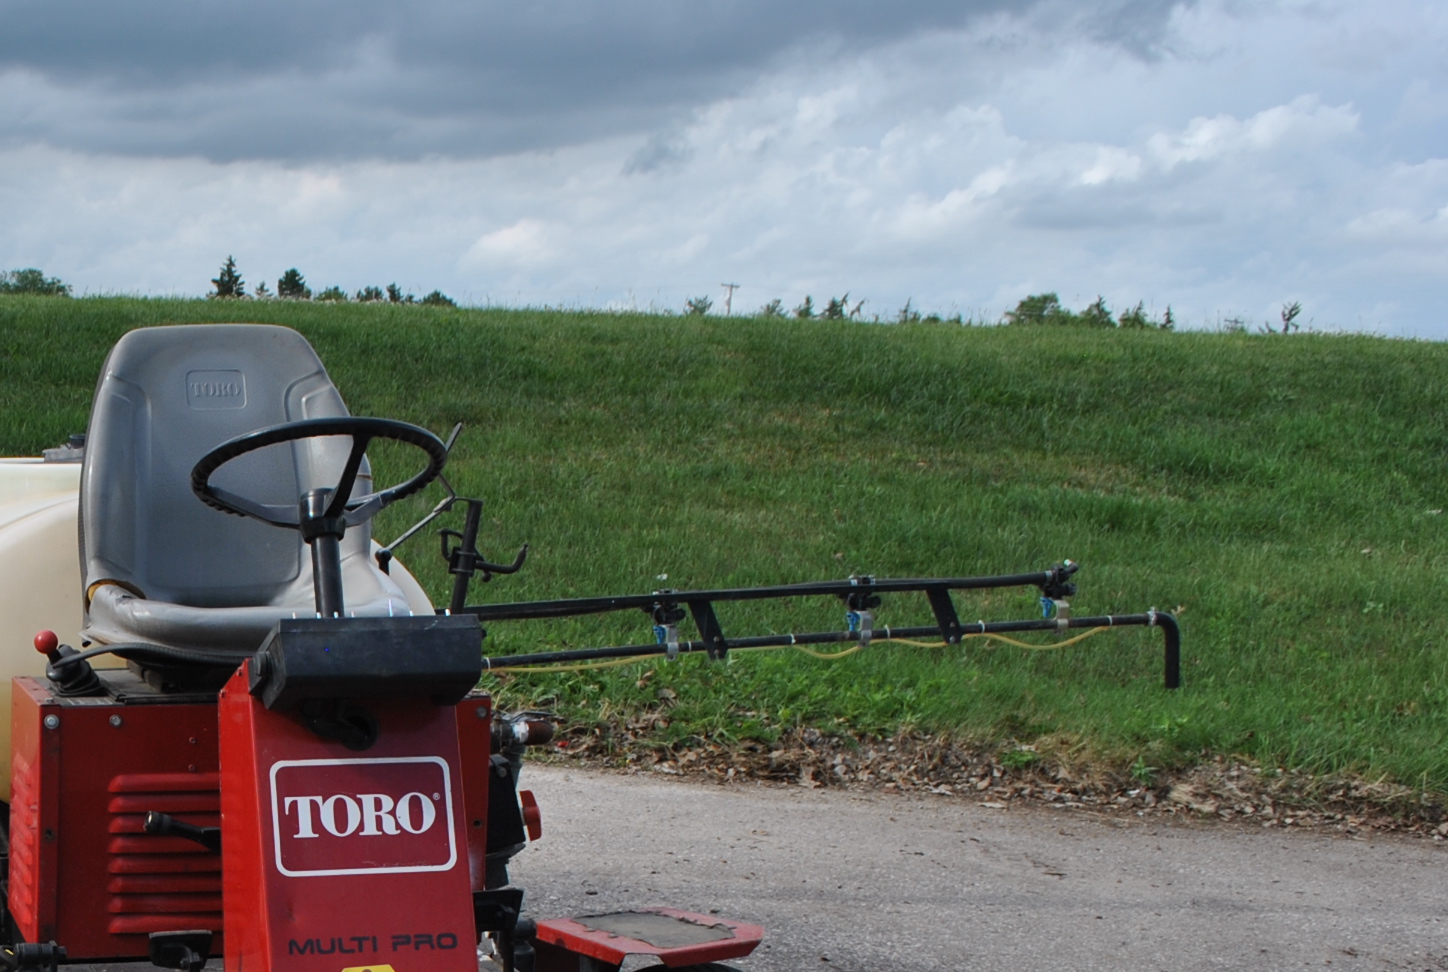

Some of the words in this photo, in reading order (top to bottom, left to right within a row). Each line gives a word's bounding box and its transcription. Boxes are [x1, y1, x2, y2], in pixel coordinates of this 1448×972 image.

[190, 382, 242, 398] TORO
[284, 792, 436, 838] TORO
[288, 936, 379, 955] MULTI
[391, 933, 458, 952] PRO
